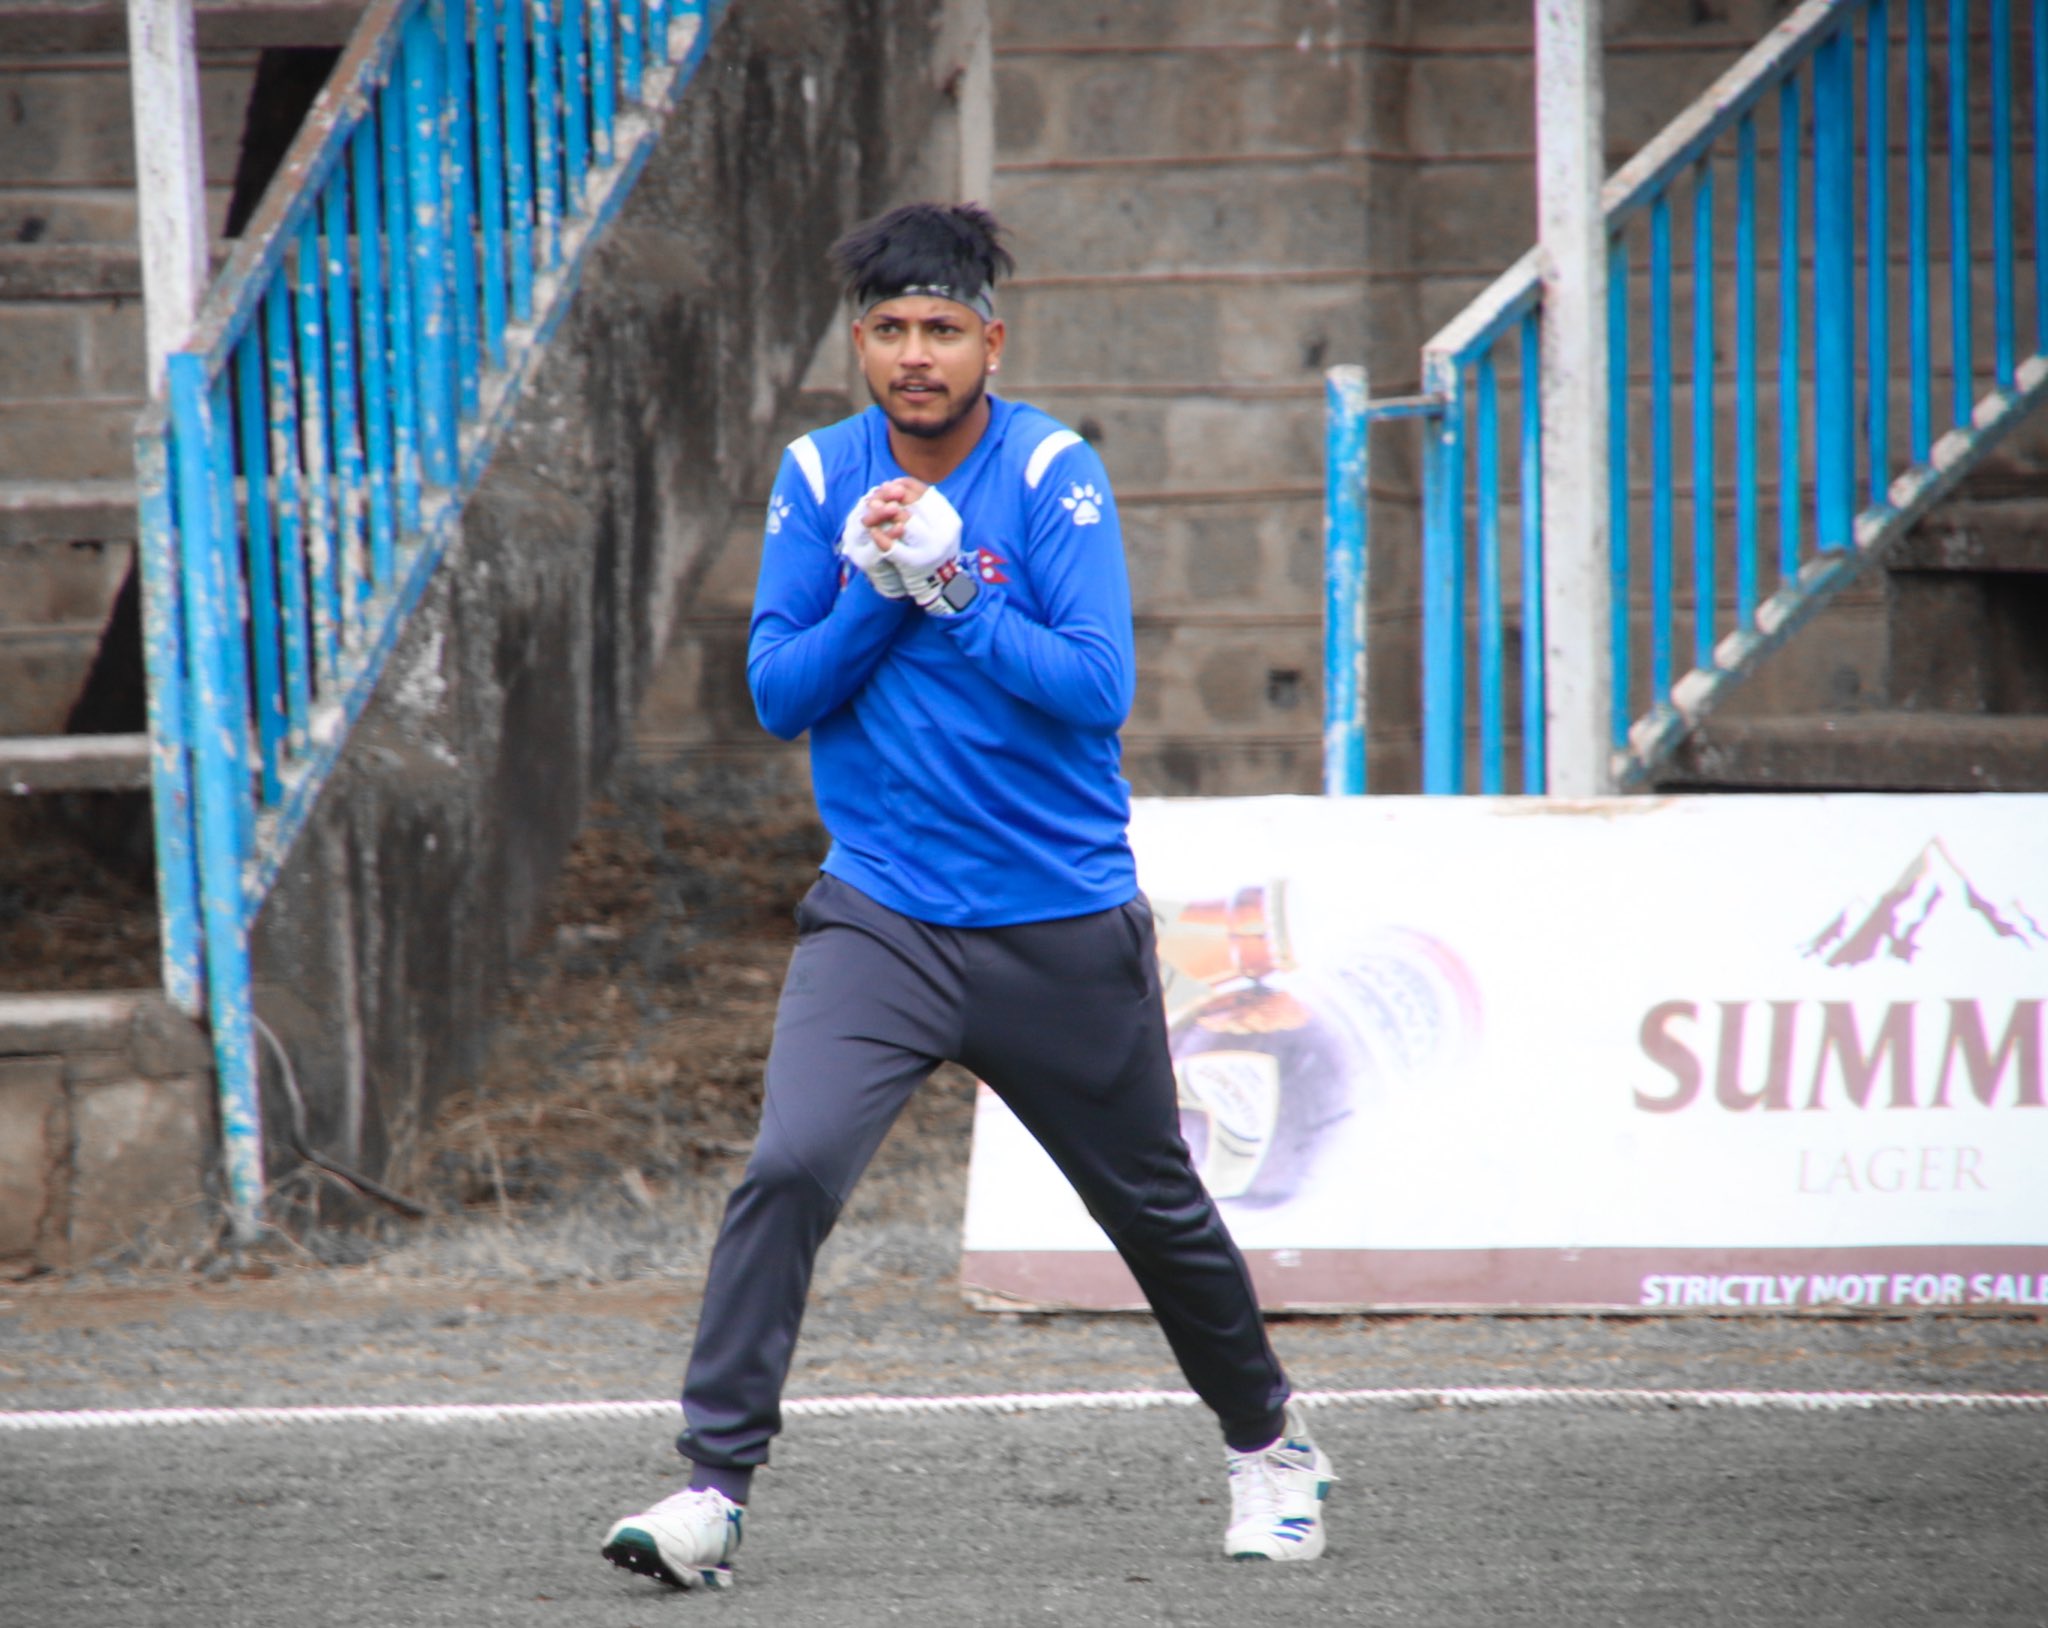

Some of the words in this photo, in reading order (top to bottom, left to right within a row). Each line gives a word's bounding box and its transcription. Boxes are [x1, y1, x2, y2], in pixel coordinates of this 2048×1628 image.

[1633, 998, 2048, 1113] SUMM
[1798, 1145, 1989, 1194] LAGER
[1641, 1275, 1804, 1306] STRICTLY
[1811, 1274, 1887, 1306] NOT
[1897, 1274, 1965, 1305] FOR
